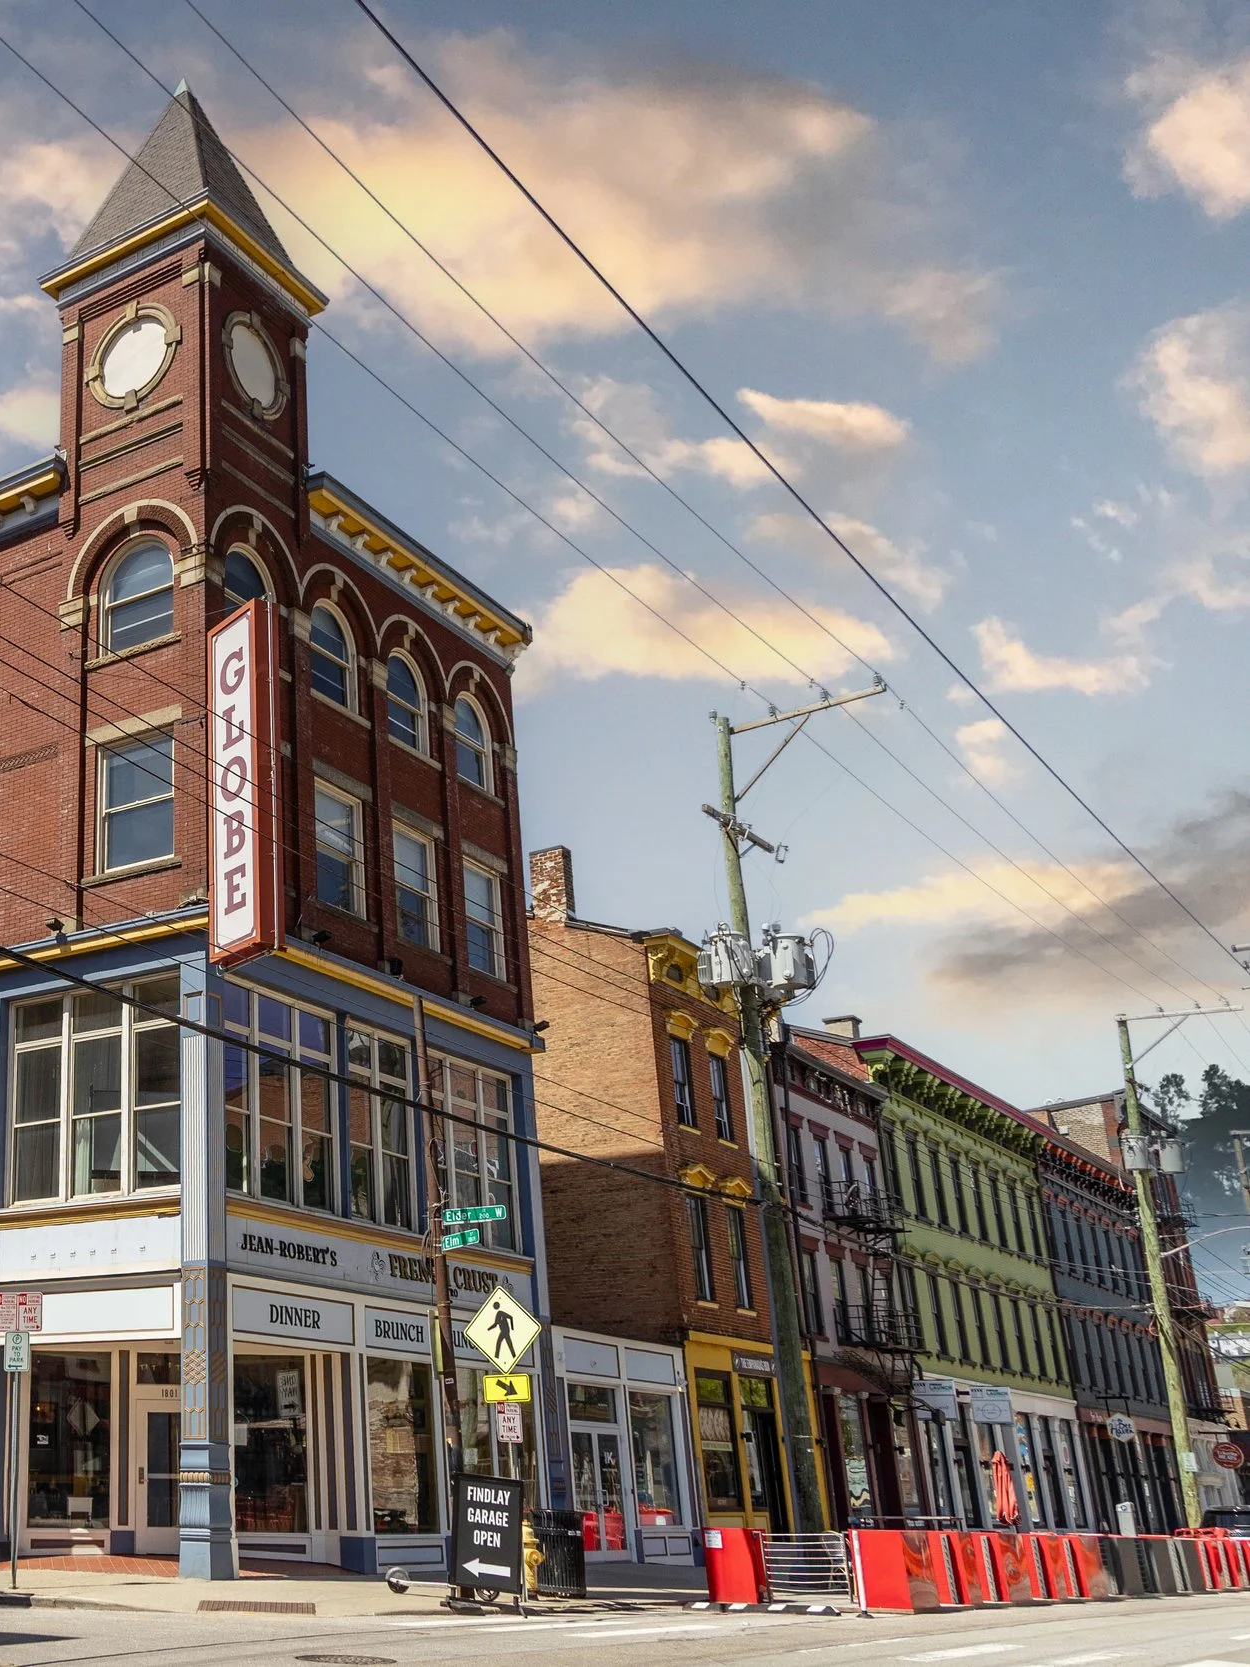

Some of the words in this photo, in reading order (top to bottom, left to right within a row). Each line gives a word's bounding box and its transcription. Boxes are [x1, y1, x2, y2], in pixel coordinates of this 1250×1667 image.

[219, 646, 247, 917] GLOBE
[446, 1211, 471, 1221] Elder
[495, 1208, 503, 1217] W
[240, 1232, 338, 1267] JEAN-ROBERT'S
[445, 1237, 460, 1248] Elm
[453, 1266, 499, 1294] CRUST
[19, 1294, 27, 1305] NO
[23, 1316, 38, 1324] TIME
[269, 1304, 321, 1330] DINNER
[374, 1318, 425, 1343] BRUNCH
[161, 1388, 178, 1398] 1801
[502, 1416, 516, 1424] ANY
[502, 1425, 517, 1434] TIME
[467, 1486, 510, 1506] FINDLAY
[467, 1507, 509, 1527] GARAGE
[473, 1530, 501, 1548] OPEN
